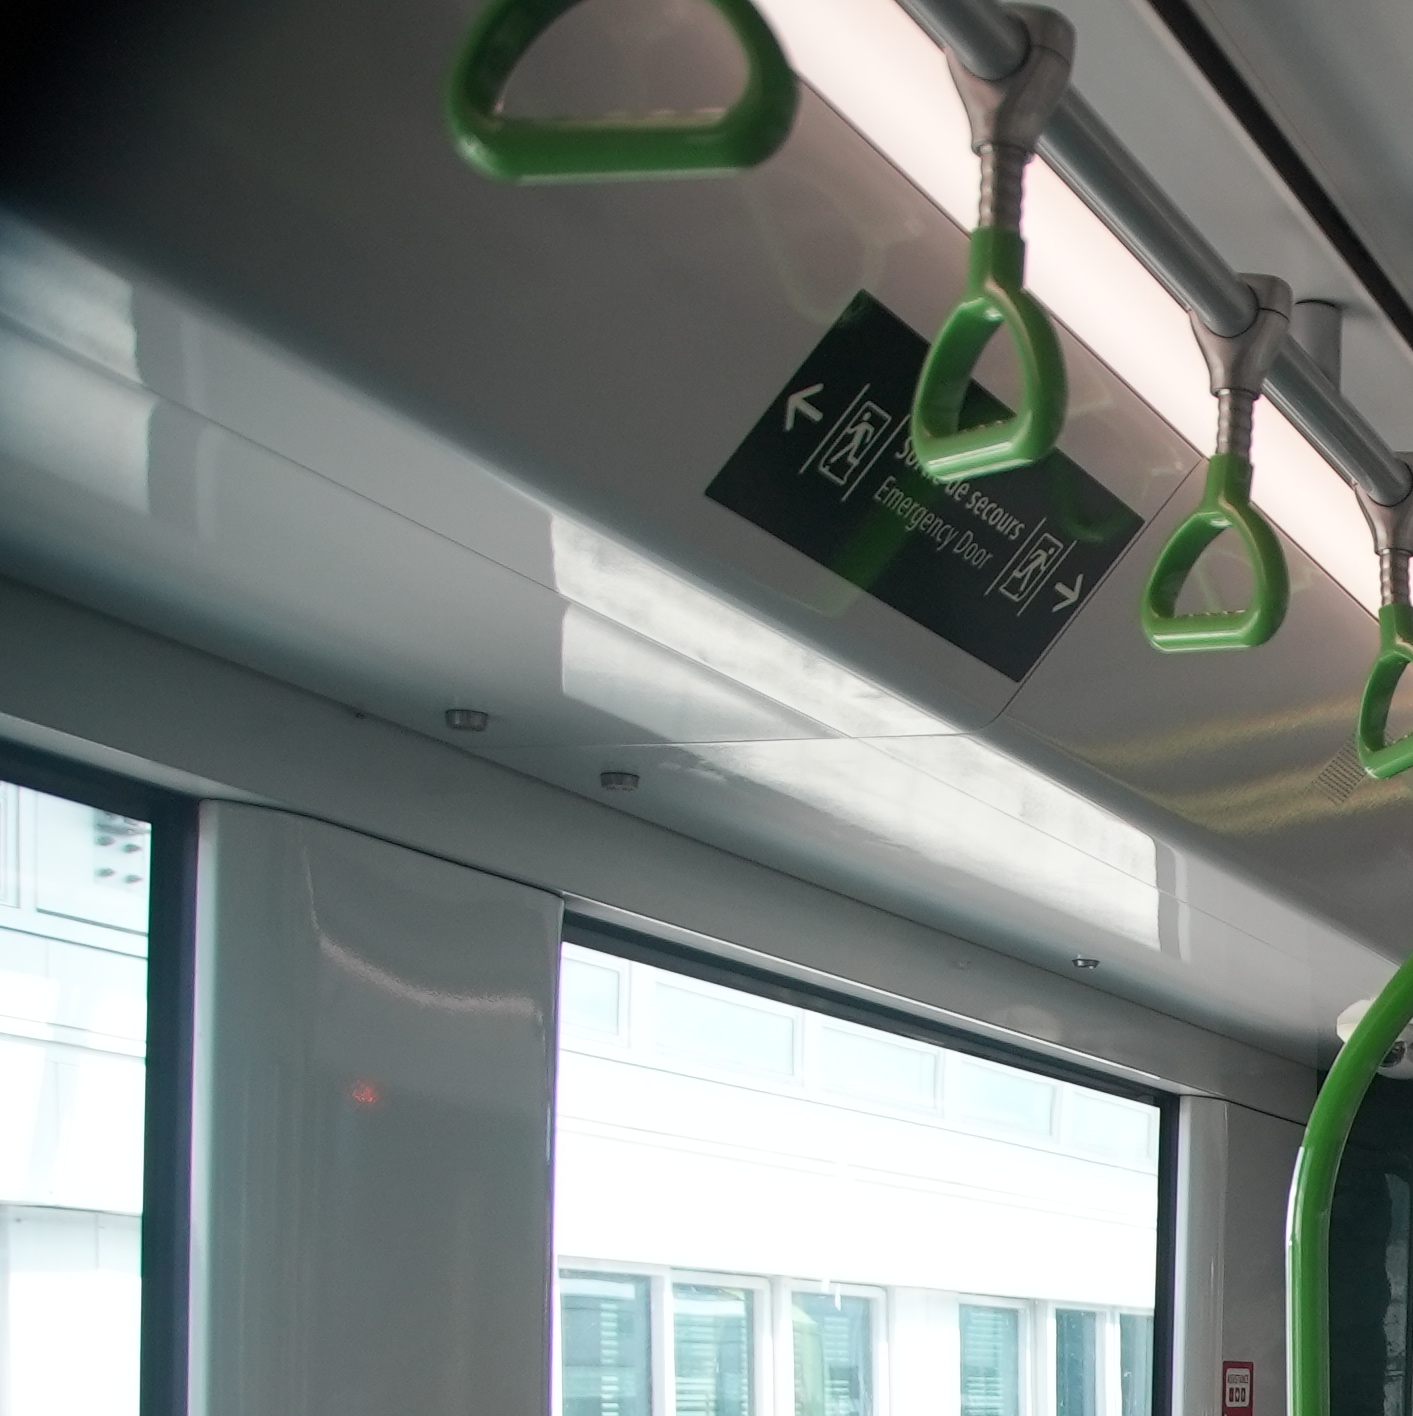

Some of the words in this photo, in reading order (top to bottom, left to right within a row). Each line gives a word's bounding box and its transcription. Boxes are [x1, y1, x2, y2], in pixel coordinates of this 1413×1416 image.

[873, 475, 958, 551] Emergency
[953, 530, 993, 569] Door
[965, 491, 1025, 540] secours
